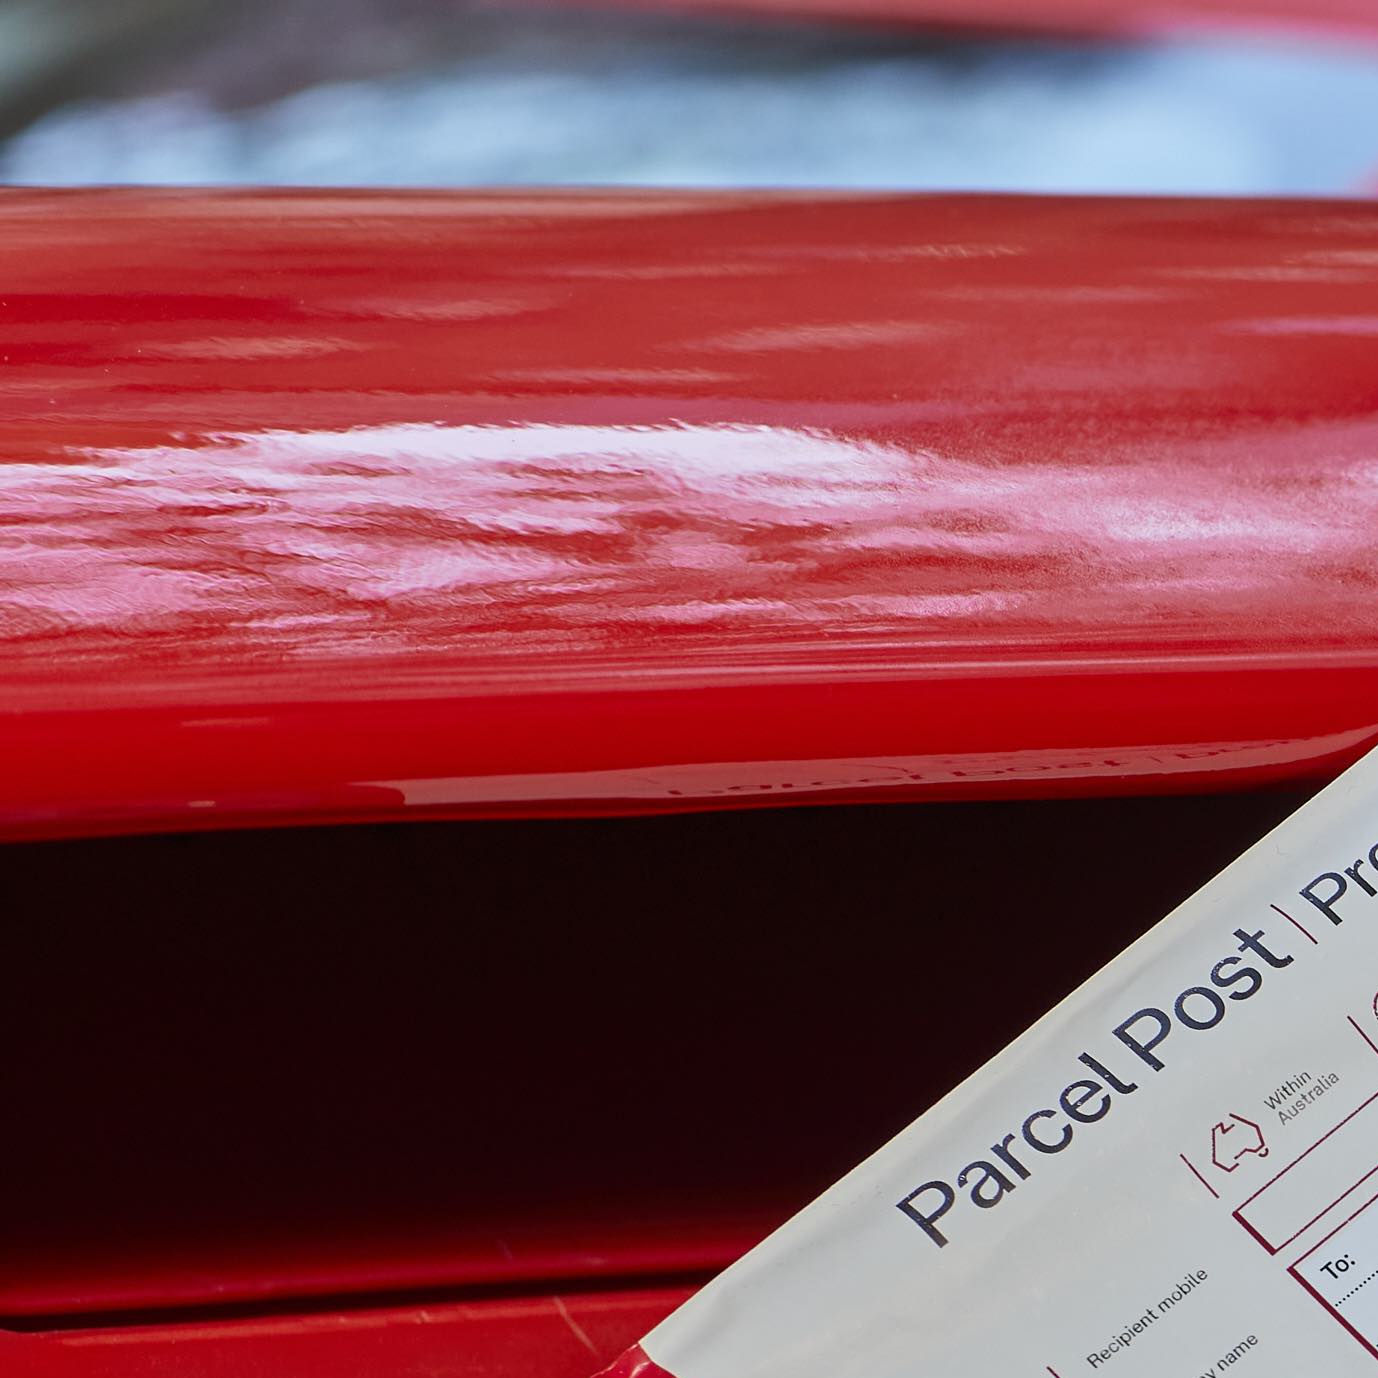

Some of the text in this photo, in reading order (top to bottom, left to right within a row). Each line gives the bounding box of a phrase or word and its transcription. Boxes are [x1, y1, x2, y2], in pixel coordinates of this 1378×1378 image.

[895, 1051, 1139, 1248] Parcel
[1111, 928, 1294, 1071] Post
[1263, 1072, 1312, 1109] Within
[1278, 1073, 1339, 1125] Australia
[1319, 1254, 1356, 1278] To:
[1086, 1270, 1208, 1368] Recipient mobile
[1216, 1335, 1258, 1371] name
